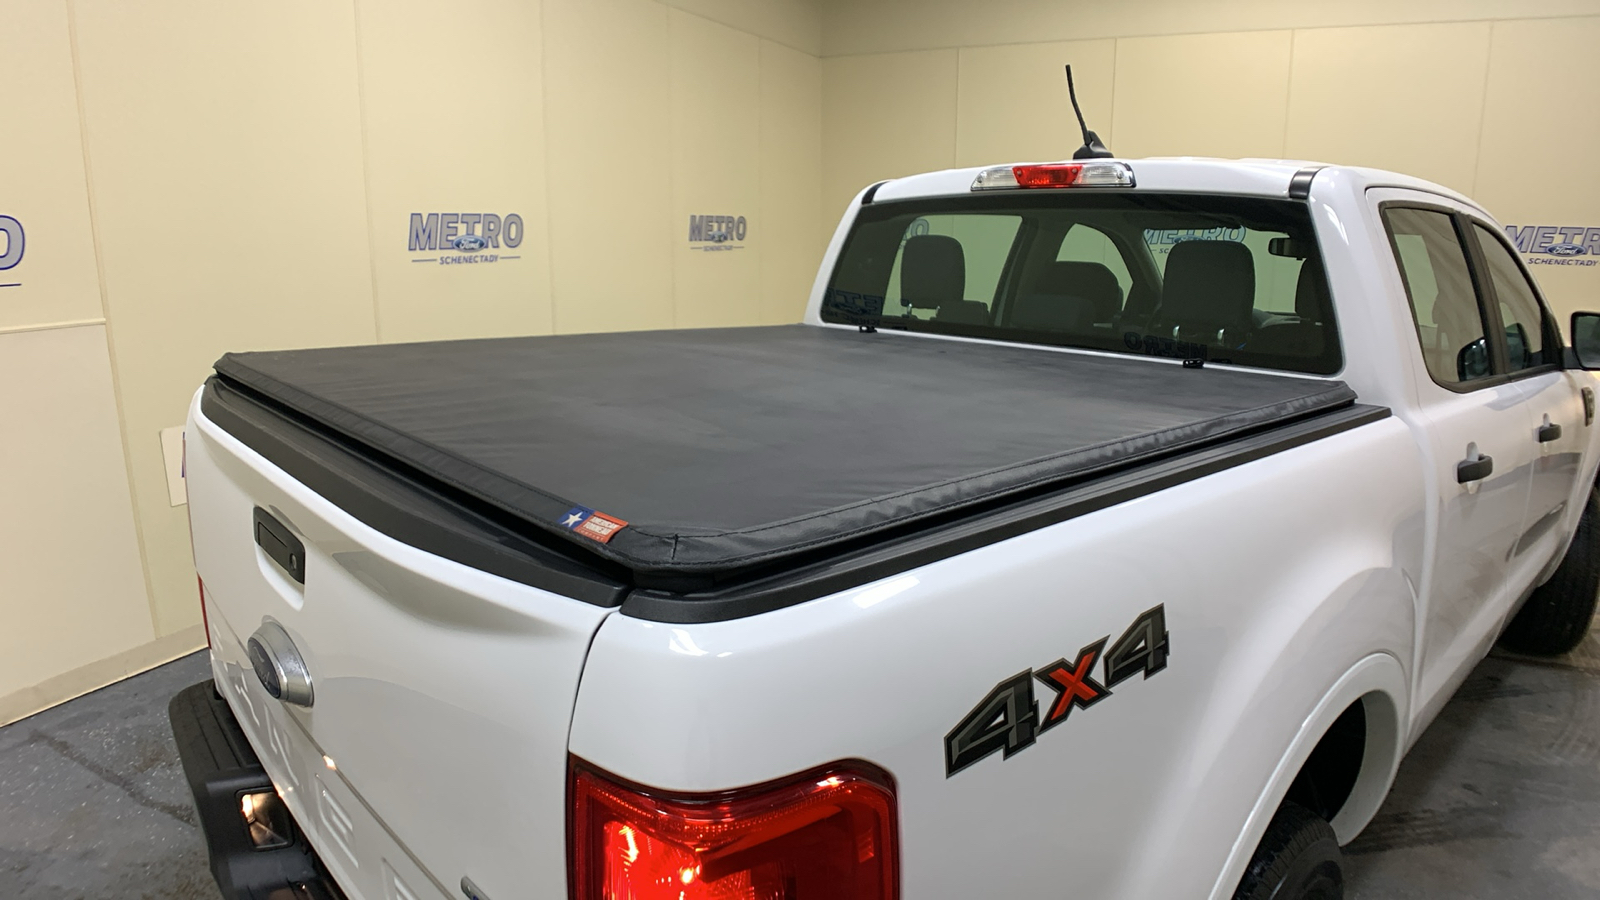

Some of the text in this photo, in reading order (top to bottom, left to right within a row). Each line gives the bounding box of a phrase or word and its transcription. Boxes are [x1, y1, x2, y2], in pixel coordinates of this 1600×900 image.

[408, 213, 524, 251] METRO
[689, 214, 747, 242] METRO
[439, 254, 499, 265] SCHENECTADY
[1528, 258, 1599, 266] SCHENECTADY
